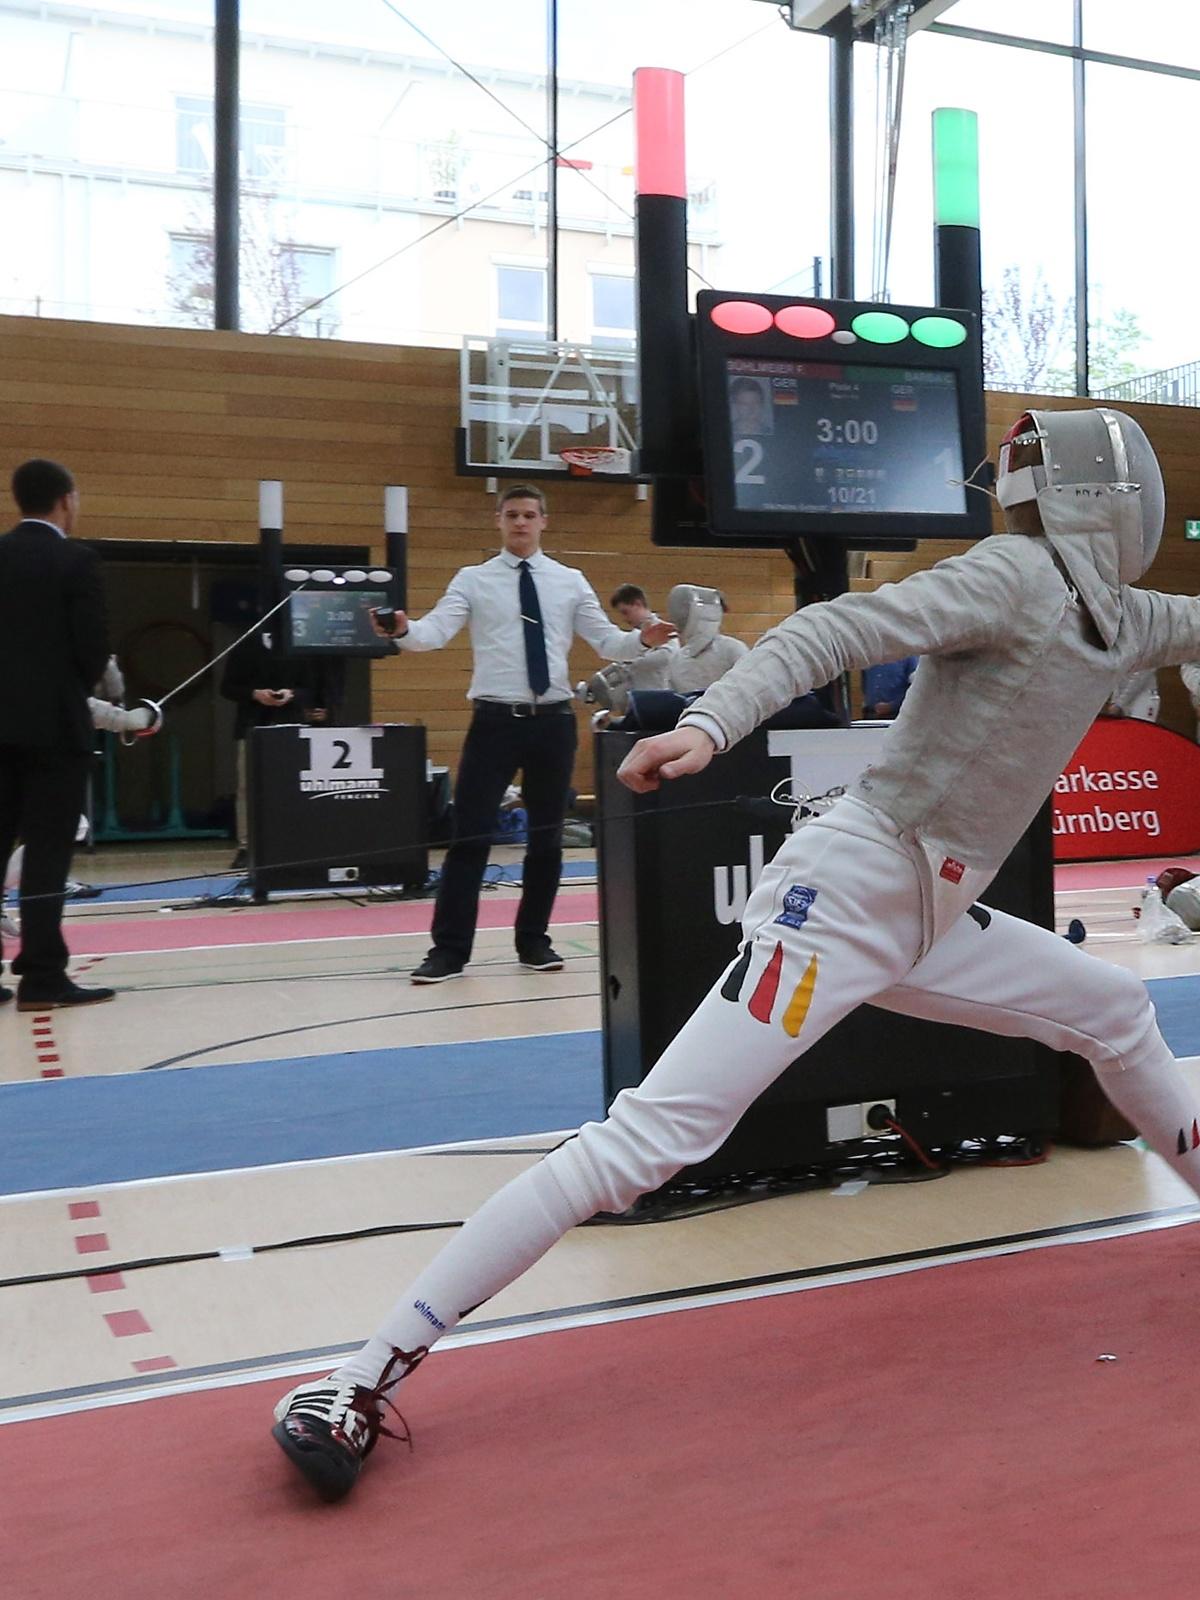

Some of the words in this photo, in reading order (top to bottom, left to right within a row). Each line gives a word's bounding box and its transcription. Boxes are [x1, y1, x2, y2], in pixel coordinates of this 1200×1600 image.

[816, 418, 878, 444] 3:00
[733, 438, 765, 484] 2
[935, 447, 959, 488] 1
[828, 487, 876, 503] 10/21
[292, 620, 306, 637] 3
[332, 740, 352, 768] 2
[300, 780, 380, 791] uhlmann
[1055, 766, 1159, 793] arkasse
